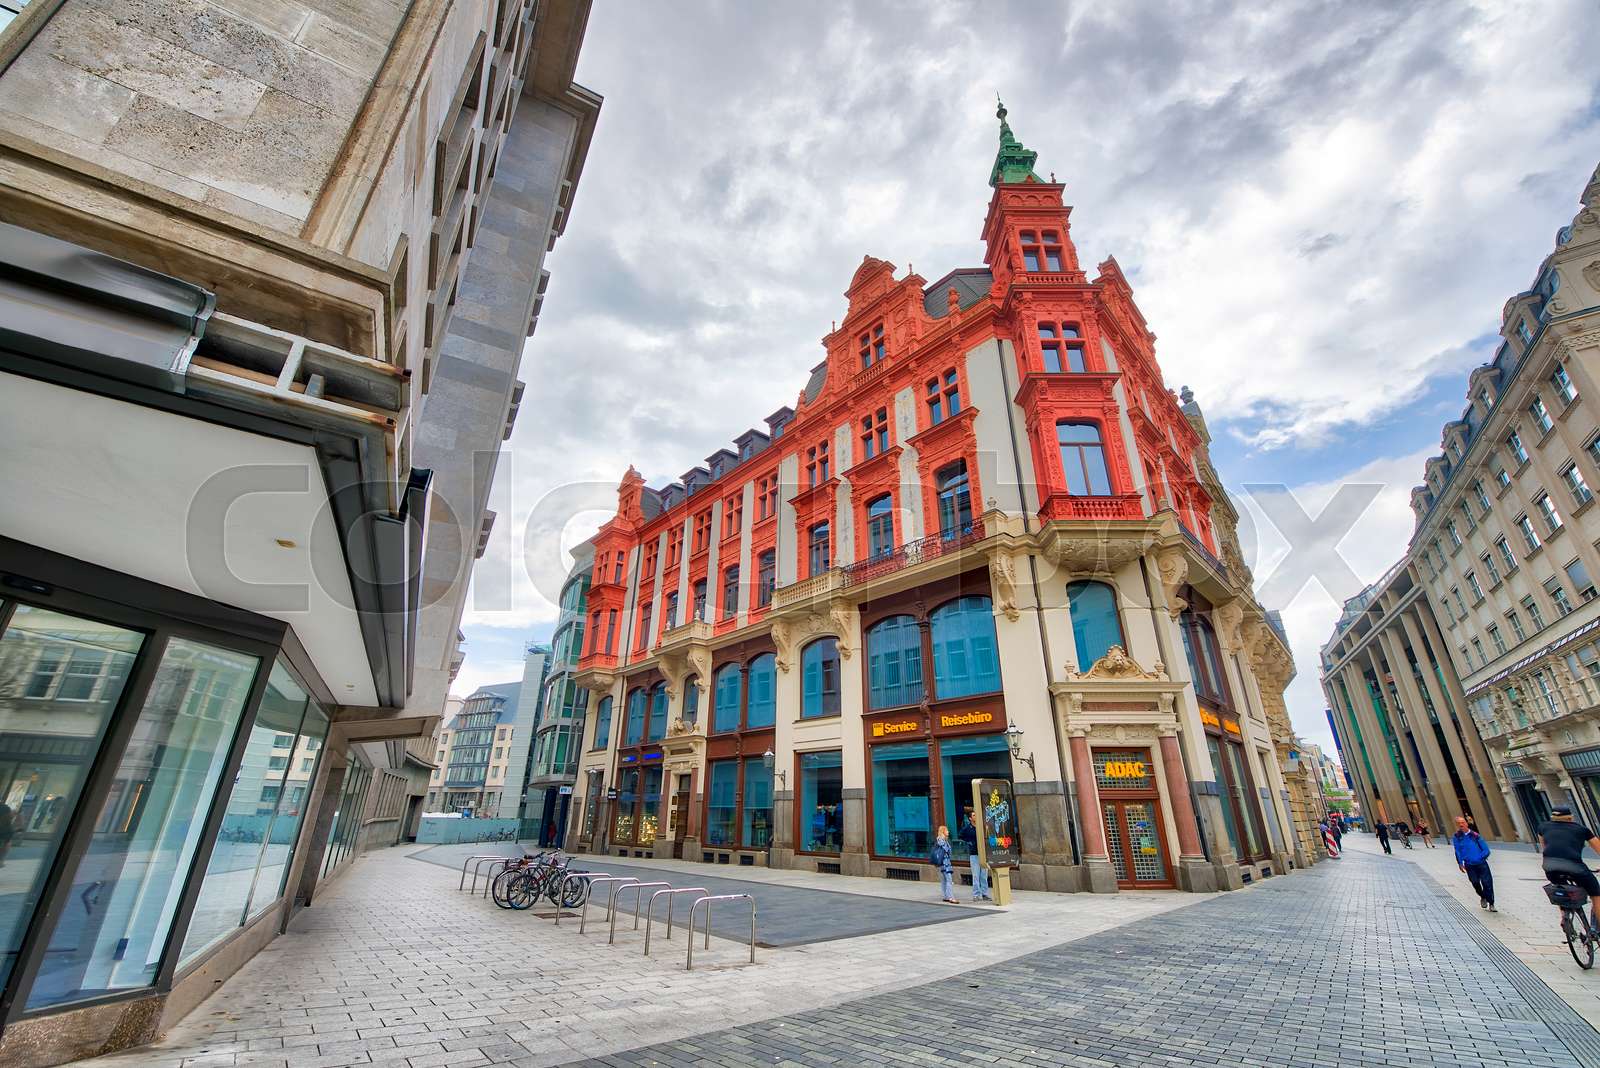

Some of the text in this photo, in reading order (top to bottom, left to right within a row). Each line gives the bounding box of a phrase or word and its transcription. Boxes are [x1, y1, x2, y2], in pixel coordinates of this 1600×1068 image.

[884, 721, 917, 734] Service
[941, 711, 992, 727] Reisebüro
[1105, 761, 1145, 778] ADAC
